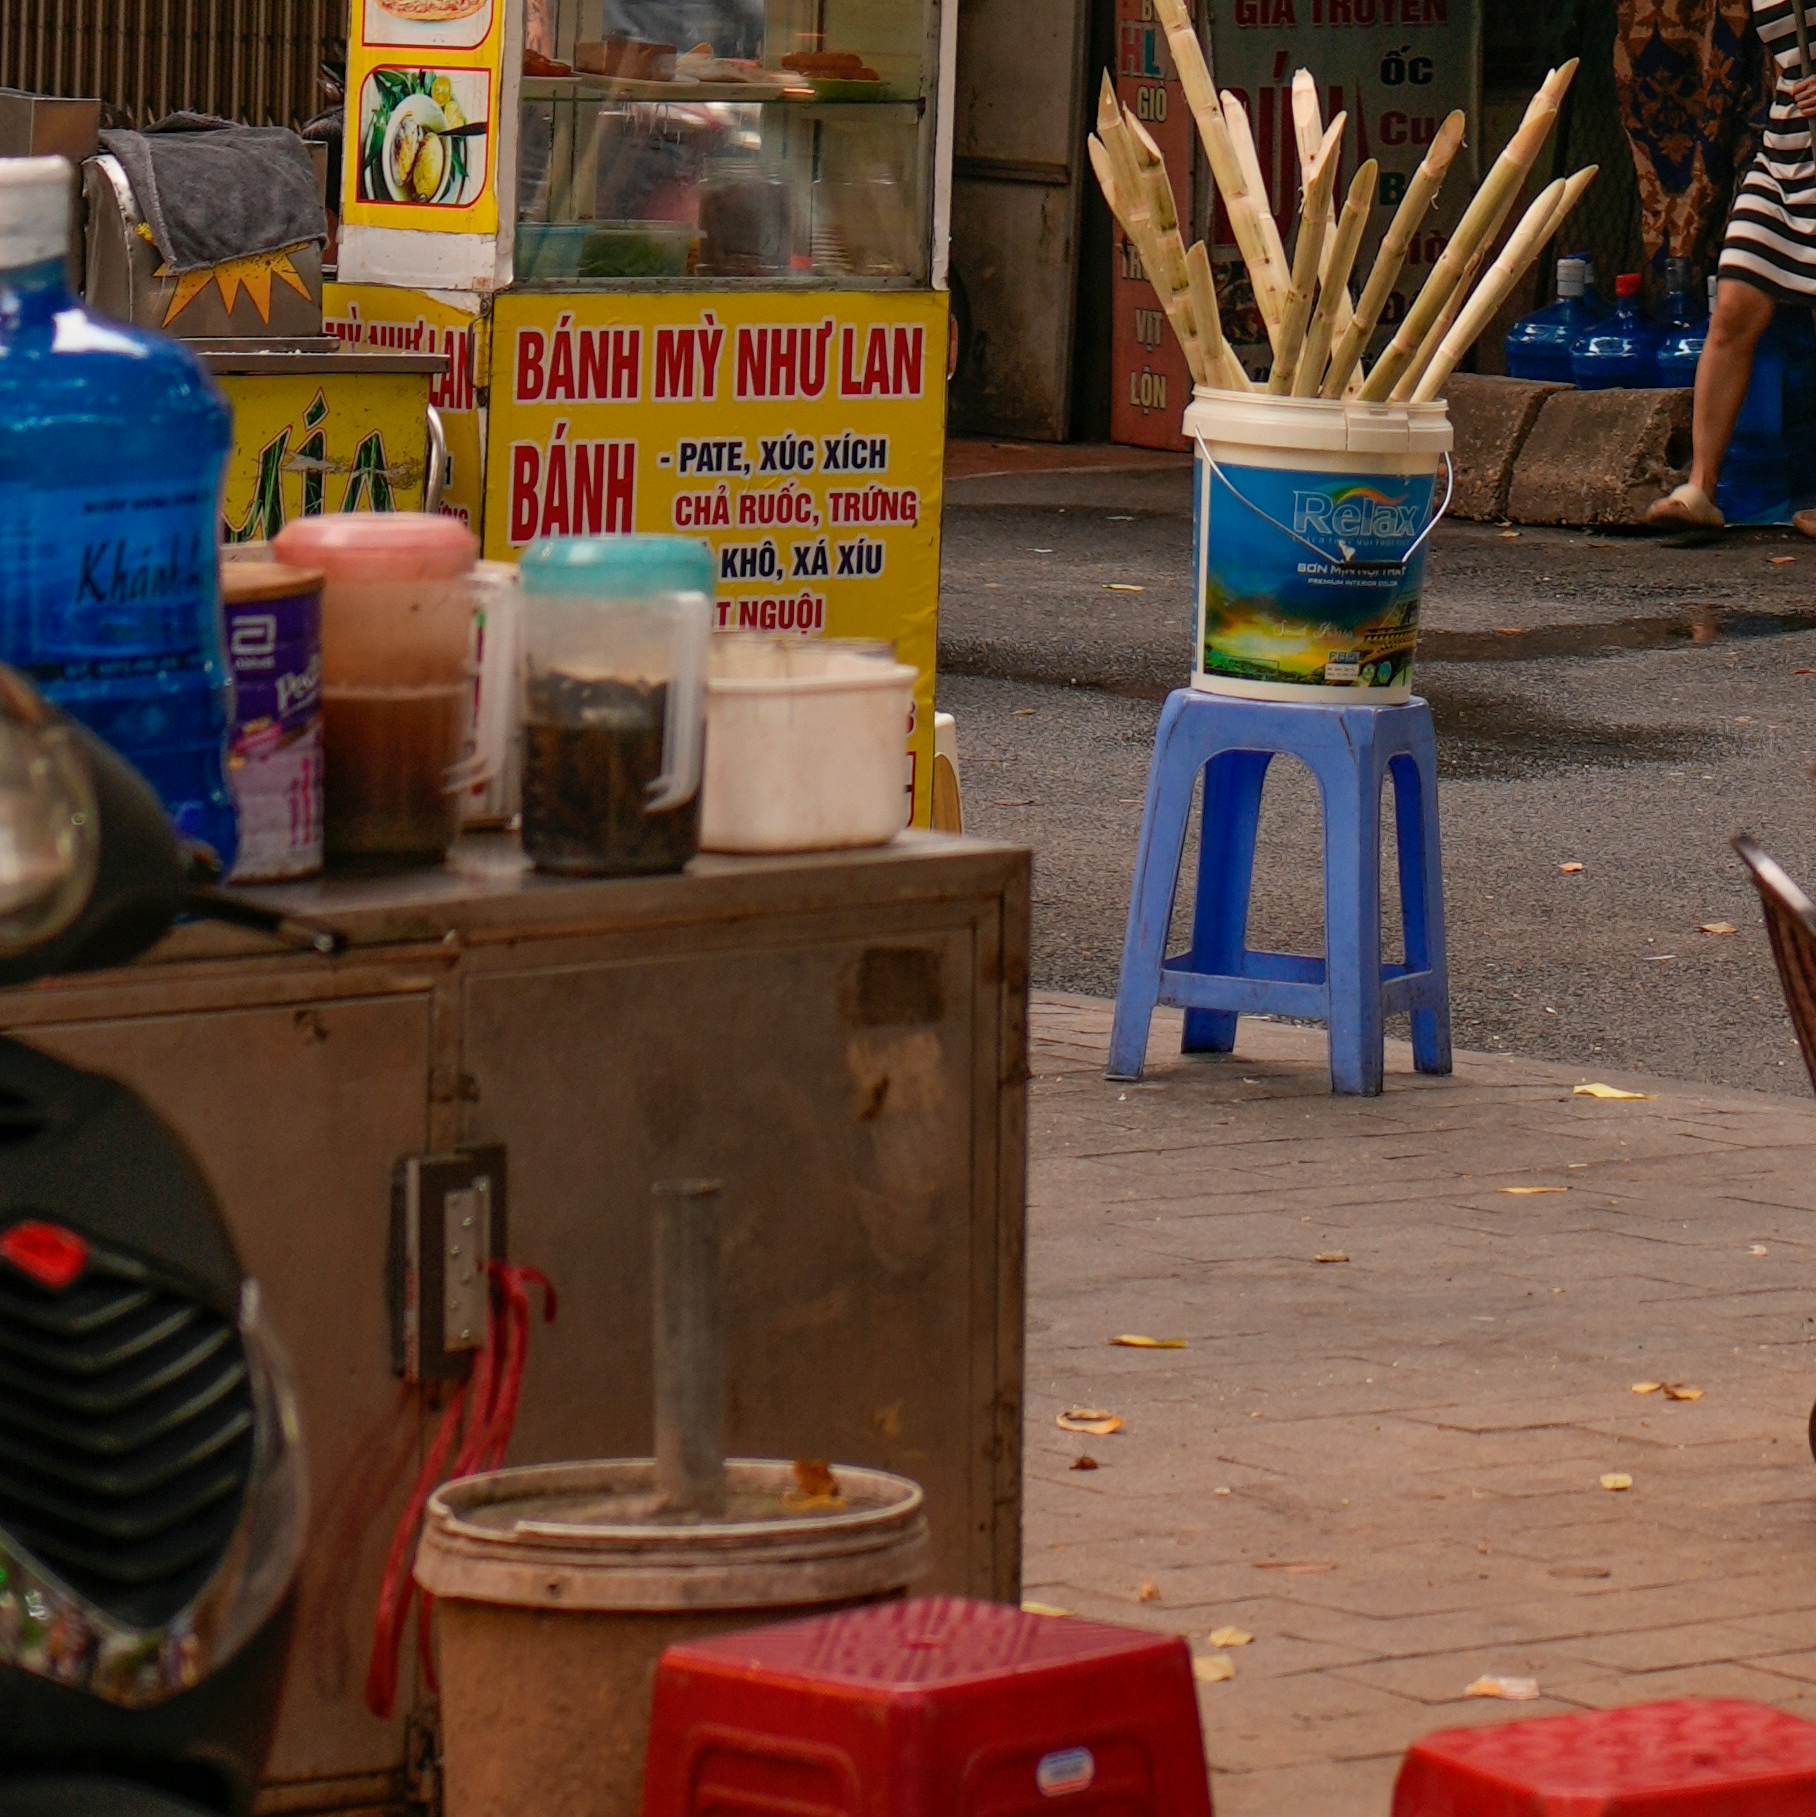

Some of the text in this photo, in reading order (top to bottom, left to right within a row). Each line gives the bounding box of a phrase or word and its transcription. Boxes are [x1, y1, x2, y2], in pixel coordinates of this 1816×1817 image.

[1135, 79, 1168, 123] GIÒ
[515, 314, 640, 400] BÁNH
[654, 313, 724, 398] MỲ
[736, 320, 834, 397] NHƯ
[840, 327, 923, 396] LAN
[679, 433, 887, 476] PATE, XÚC XÍCH
[510, 422, 635, 542] BÁNH
[675, 484, 730, 526] CHẢ
[1292, 489, 1417, 538] Relax
[720, 538, 883, 581] KHÔ, XÁ XÍU
